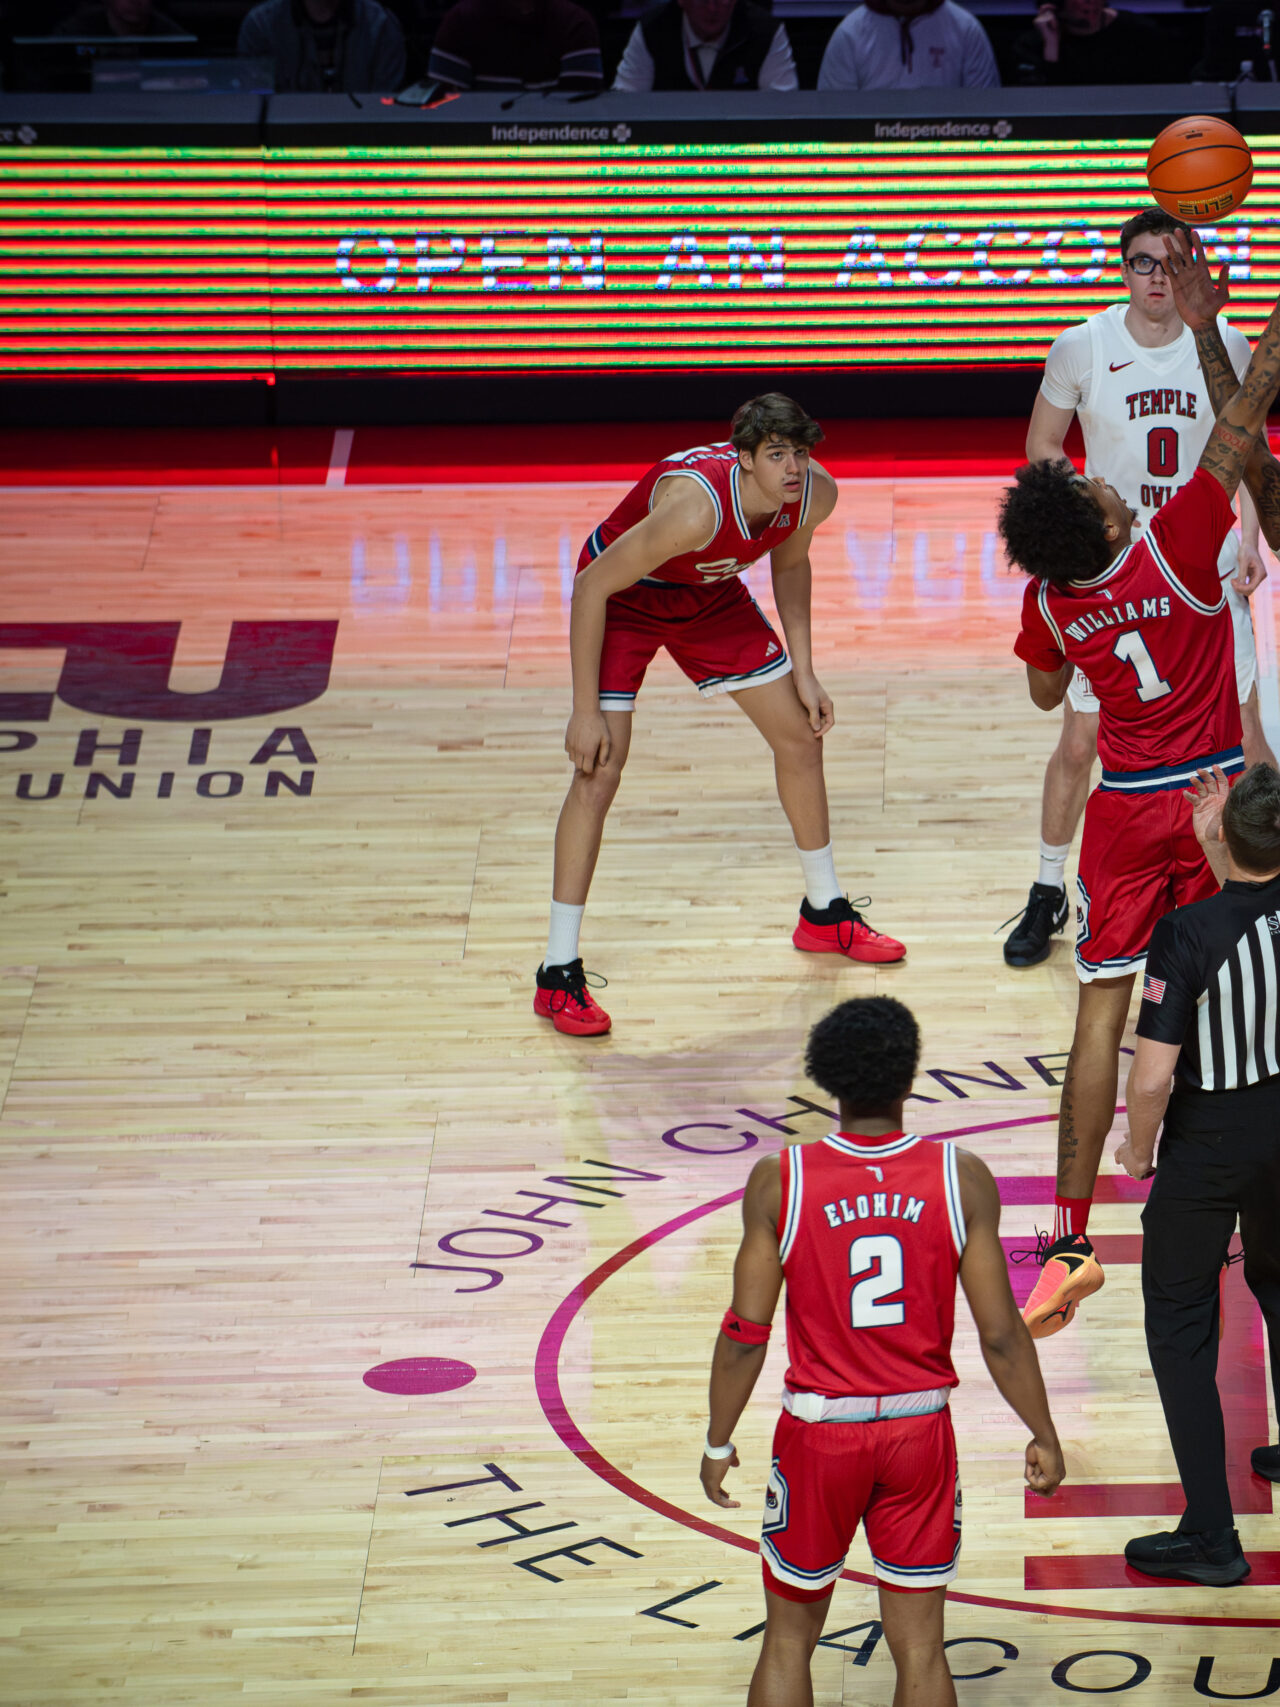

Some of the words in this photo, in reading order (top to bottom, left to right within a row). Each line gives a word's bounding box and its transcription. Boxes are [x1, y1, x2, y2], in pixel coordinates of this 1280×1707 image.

[491, 124, 609, 143] Independence
[875, 121, 990, 139] Independence
[1178, 193, 1233, 215] ELITE
[333, 229, 606, 292] OPEN
[655, 227, 785, 289] AN
[1126, 388, 1197, 420] TEMPLE
[1147, 427, 1178, 477] 0
[1141, 483, 1187, 508] OW
[1064, 596, 1171, 643] WILLIAMS
[1112, 629, 1174, 703] 1
[15, 771, 315, 800] UNION
[410, 1159, 666, 1294] JOHN
[661, 1047, 1136, 1155] CHNE
[823, 1193, 926, 1228] ELOHIM
[849, 1233, 905, 1330] 2
[404, 1462, 645, 1583] THE
